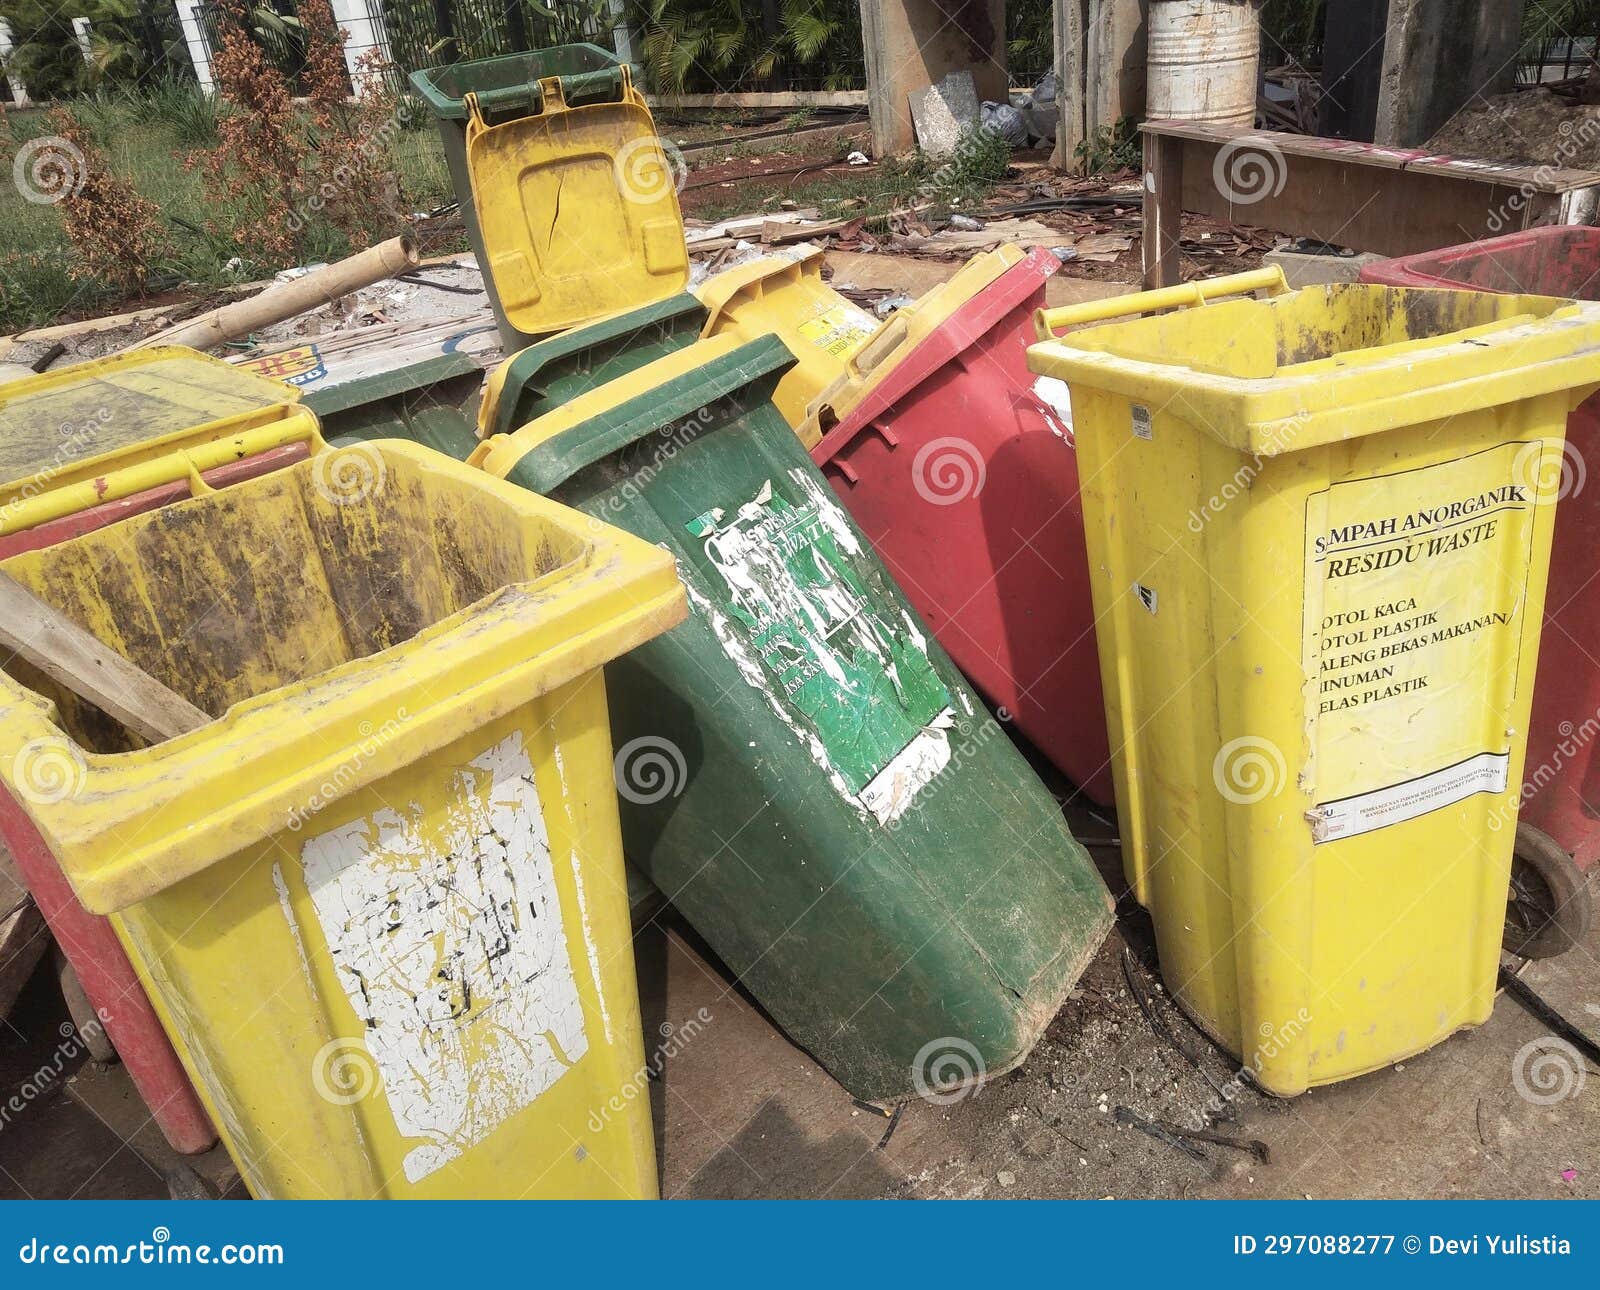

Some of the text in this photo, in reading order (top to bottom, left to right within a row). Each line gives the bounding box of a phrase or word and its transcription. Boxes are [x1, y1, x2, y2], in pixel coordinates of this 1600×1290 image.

[1315, 486, 1526, 554] SMPAH ANORGANIK
[1327, 520, 1498, 580] RESIDU WASTE
[1320, 611, 1438, 651] OTOL PLASTIK
[1321, 597, 1417, 630] OTOL KACA
[1319, 649, 1376, 672] ALENG
[1380, 634, 1428, 659] BEKAS
[1319, 665, 1394, 694] INUMAN
[1319, 676, 1429, 714] ELAS PLASTIK
